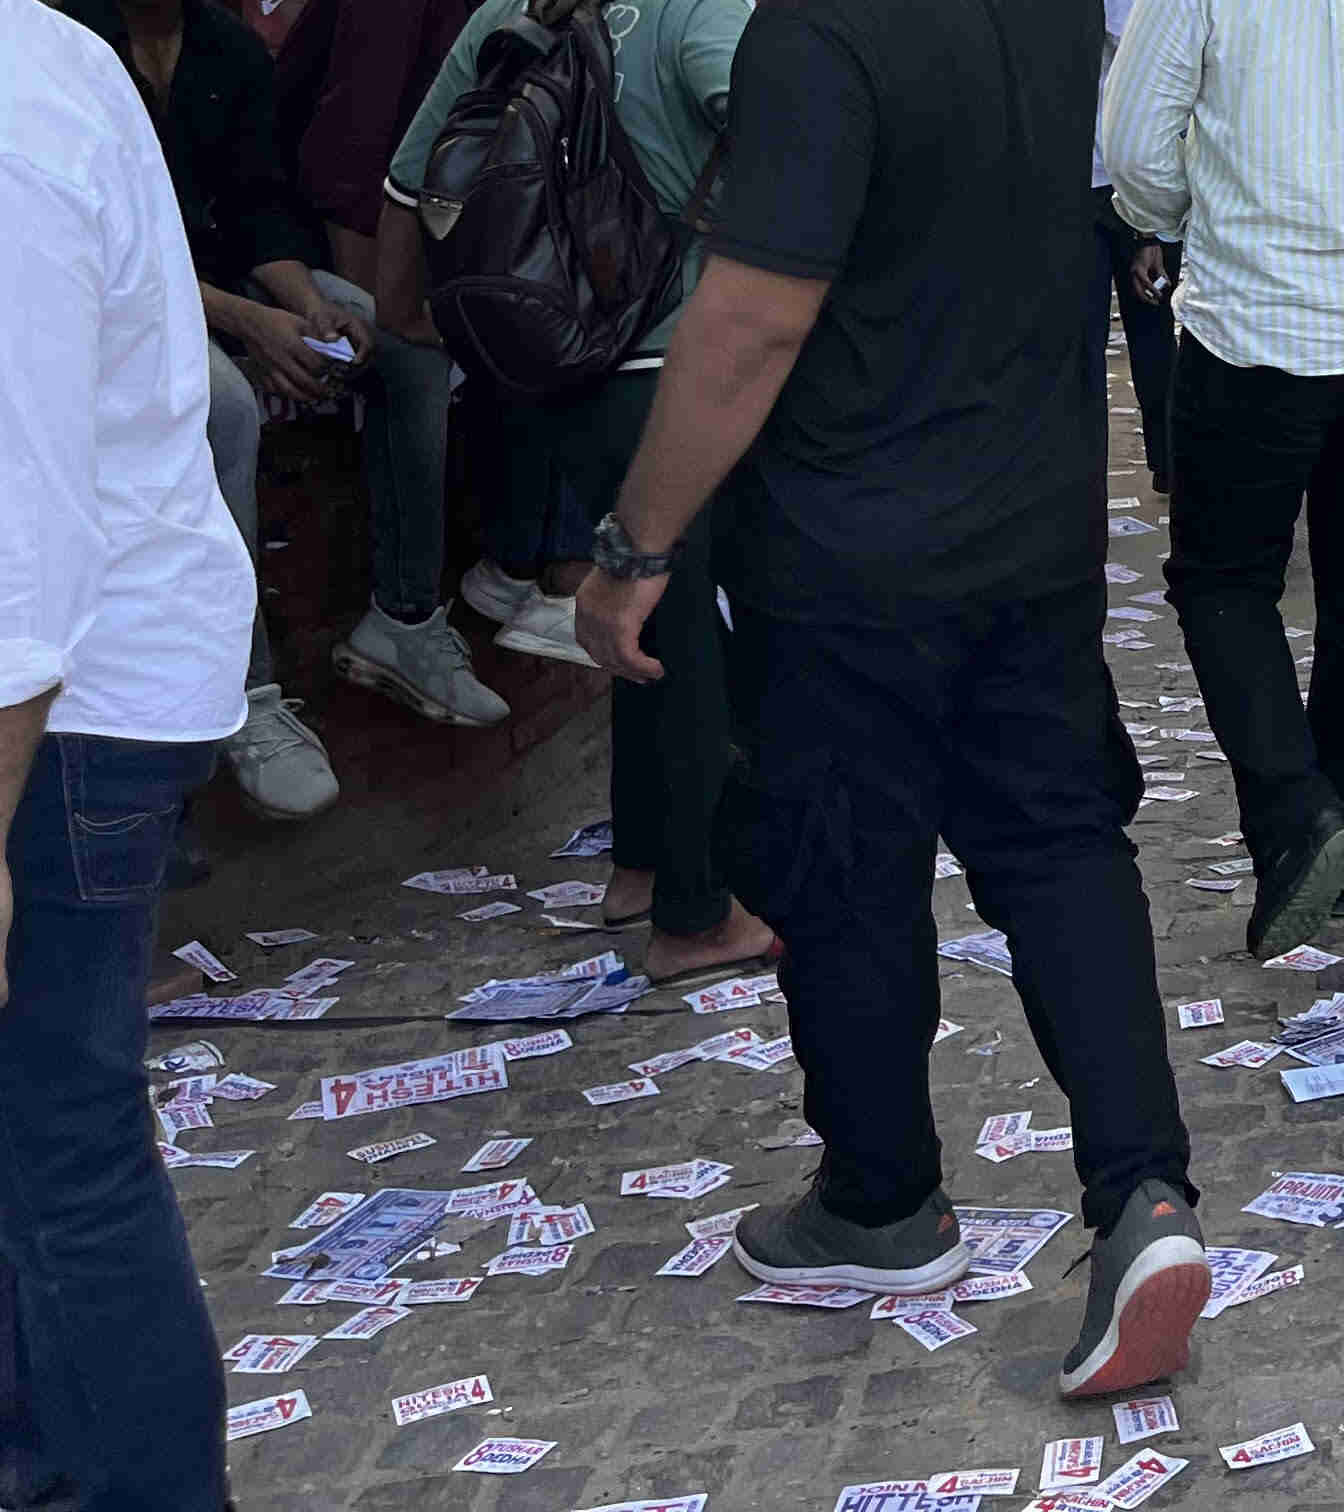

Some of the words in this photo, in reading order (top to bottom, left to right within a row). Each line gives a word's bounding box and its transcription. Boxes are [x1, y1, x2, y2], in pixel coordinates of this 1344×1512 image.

[954, 1287, 970, 1298] 8
[970, 1282, 1022, 1296] DEDHA
[463, 1444, 493, 1466] 8
[483, 1454, 531, 1465] DEDHA
